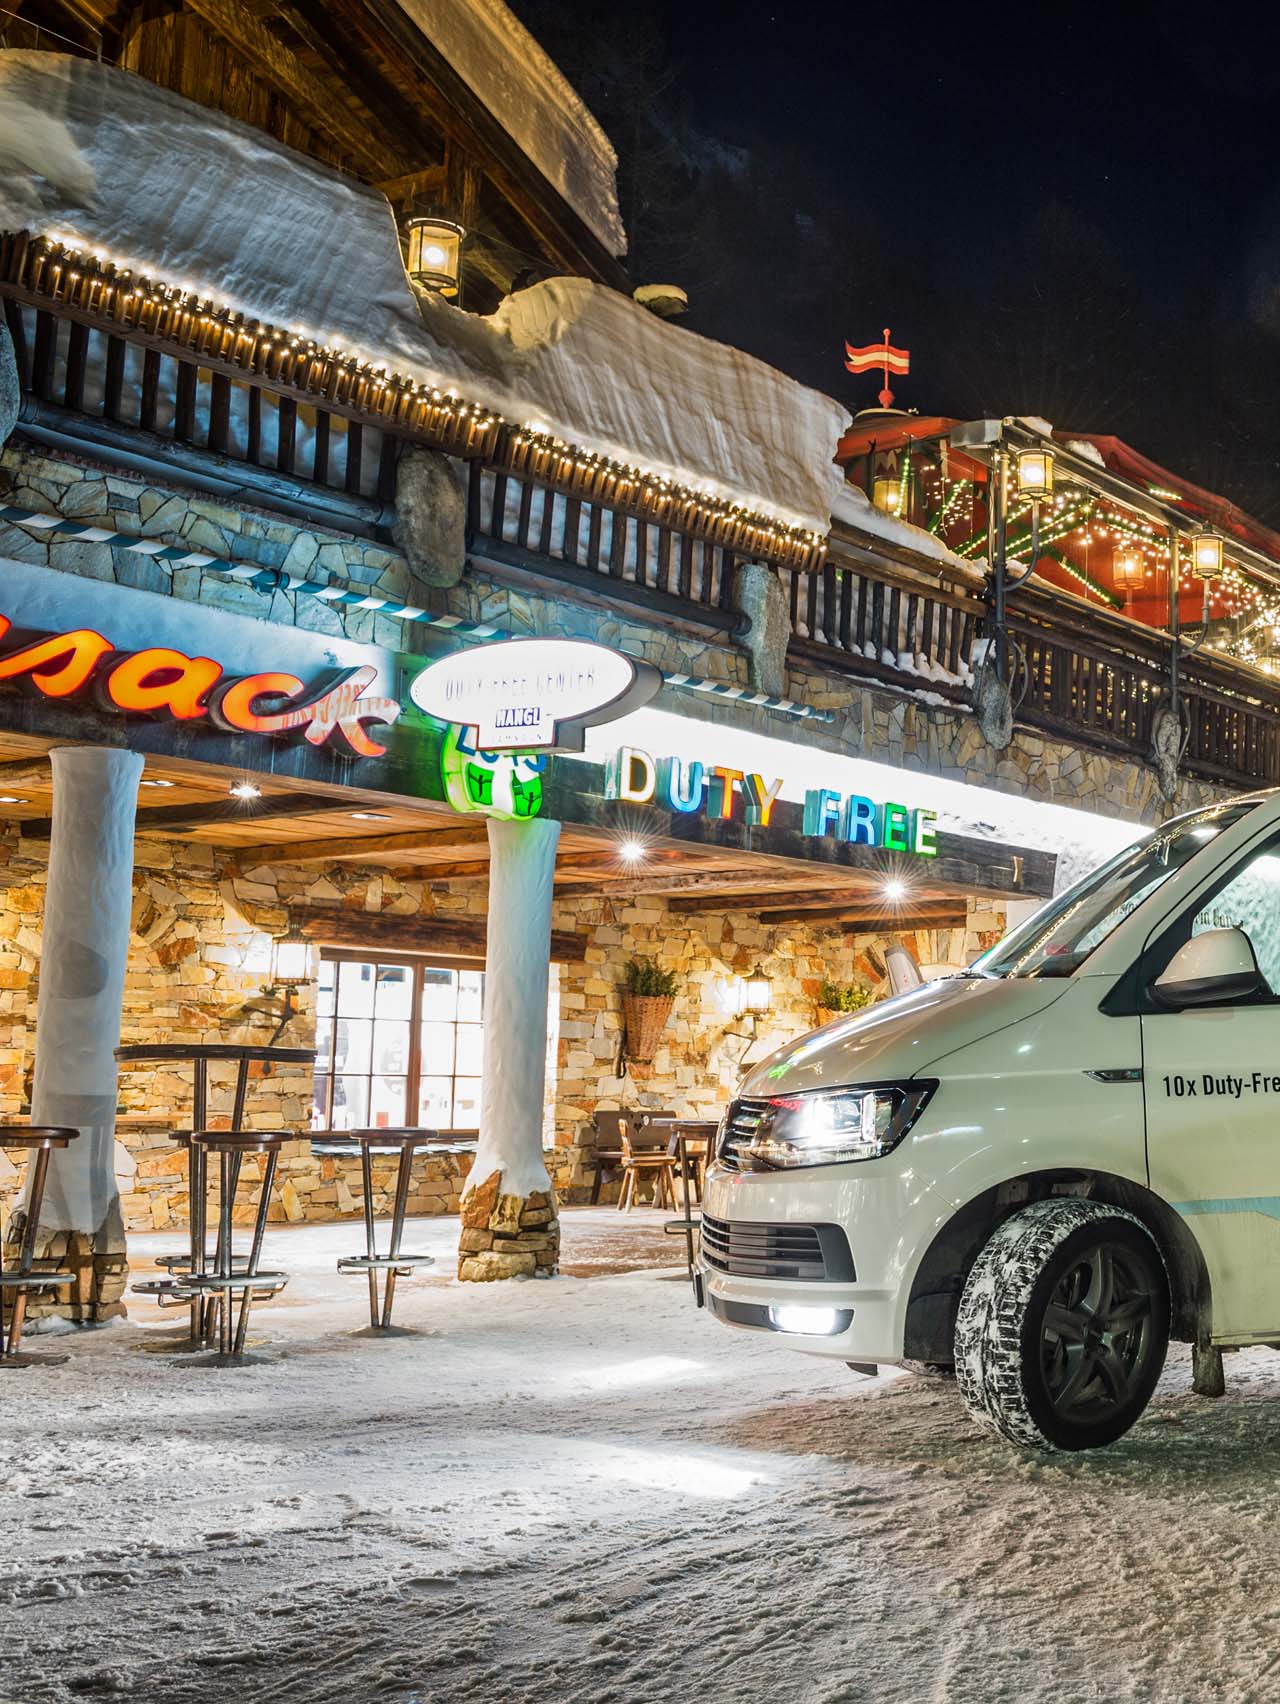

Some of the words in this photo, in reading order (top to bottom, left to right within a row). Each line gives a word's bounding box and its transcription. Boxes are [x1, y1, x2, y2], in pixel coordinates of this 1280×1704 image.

[495, 707, 541, 728] HANGL
[616, 746, 784, 828] DUTY
[813, 788, 938, 858] FREE
[1163, 1074, 1198, 1097] 10x
